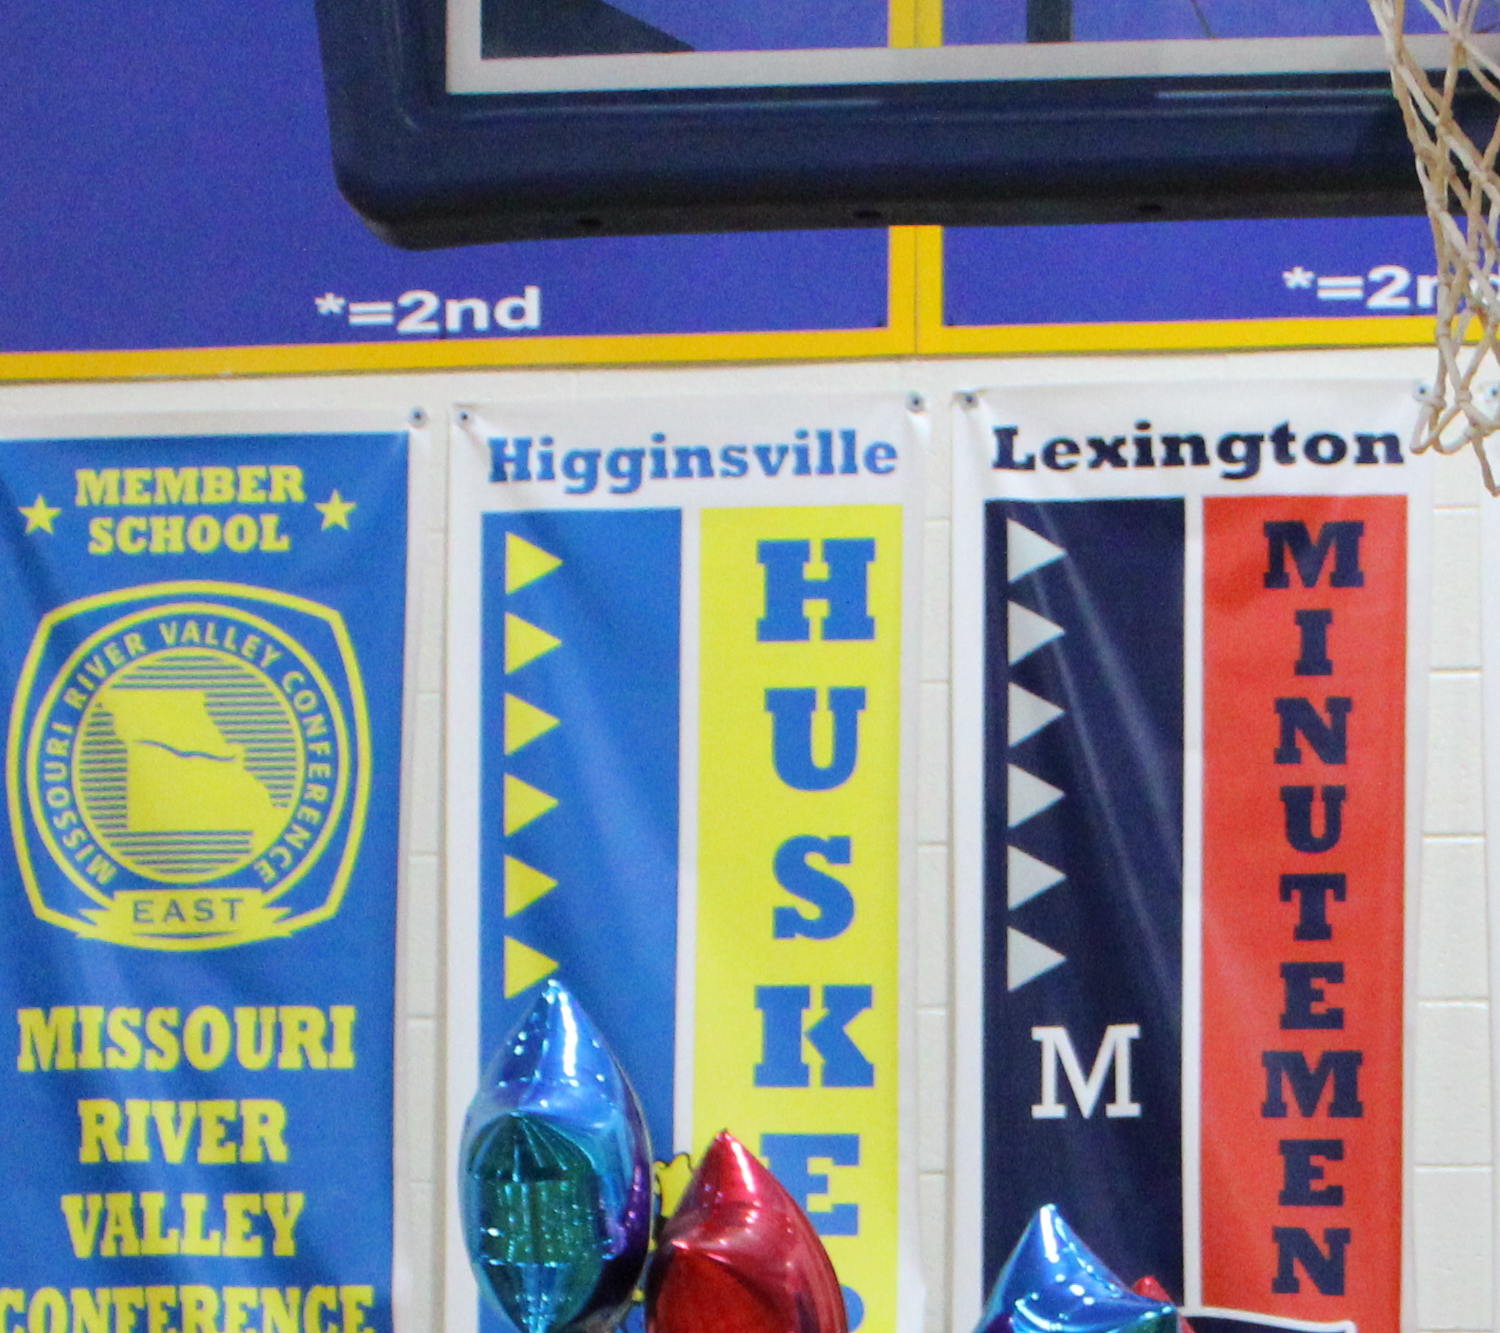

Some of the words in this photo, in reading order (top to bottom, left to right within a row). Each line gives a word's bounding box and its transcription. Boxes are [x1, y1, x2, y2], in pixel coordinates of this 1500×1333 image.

[487, 429, 899, 496] Higginsville
[990, 418, 1407, 480] Lexington
[74, 465, 306, 509] MEMBER
[86, 512, 290, 556] SCHOOL
[62, 632, 148, 712] RIVER
[159, 620, 283, 669] VALLEY
[44, 720, 120, 886] MISSOURI
[253, 670, 333, 885] CONFERENCE
[132, 896, 245, 926] EAST
[1260, 520, 1365, 1297] MINUTEMEN
[15, 1004, 357, 1075] MISSOURI
[1029, 1023, 1143, 1120] M
[76, 1097, 289, 1166] RIVER
[60, 1189, 307, 1260] VALLEY
